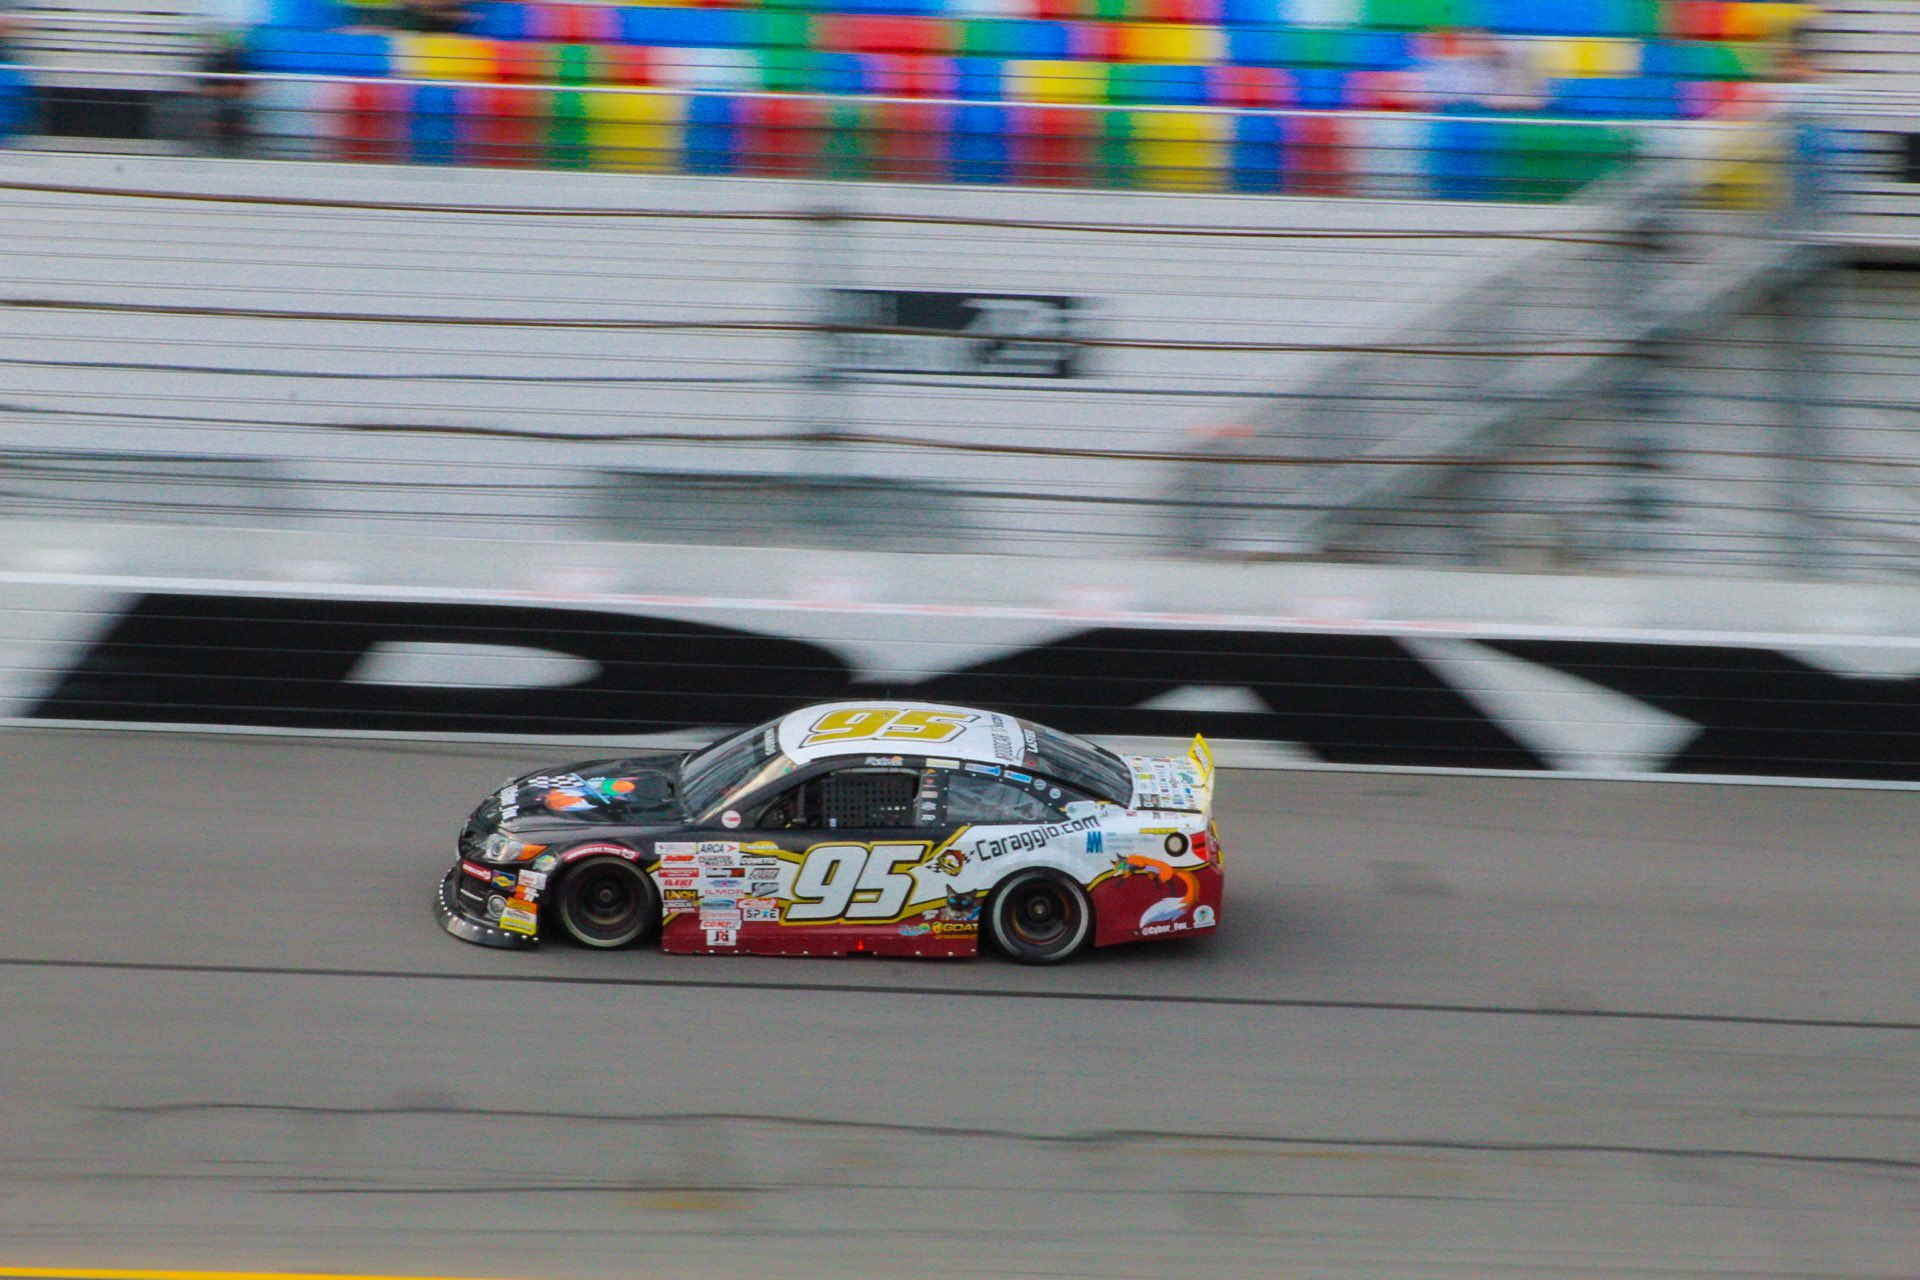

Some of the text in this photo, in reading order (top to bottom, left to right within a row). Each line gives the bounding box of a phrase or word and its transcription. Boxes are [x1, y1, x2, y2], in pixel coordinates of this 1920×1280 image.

[798, 707, 982, 750] 95
[700, 844, 724, 853] ARCA
[976, 815, 1101, 862] Caraggio.com
[783, 843, 930, 921] 95
